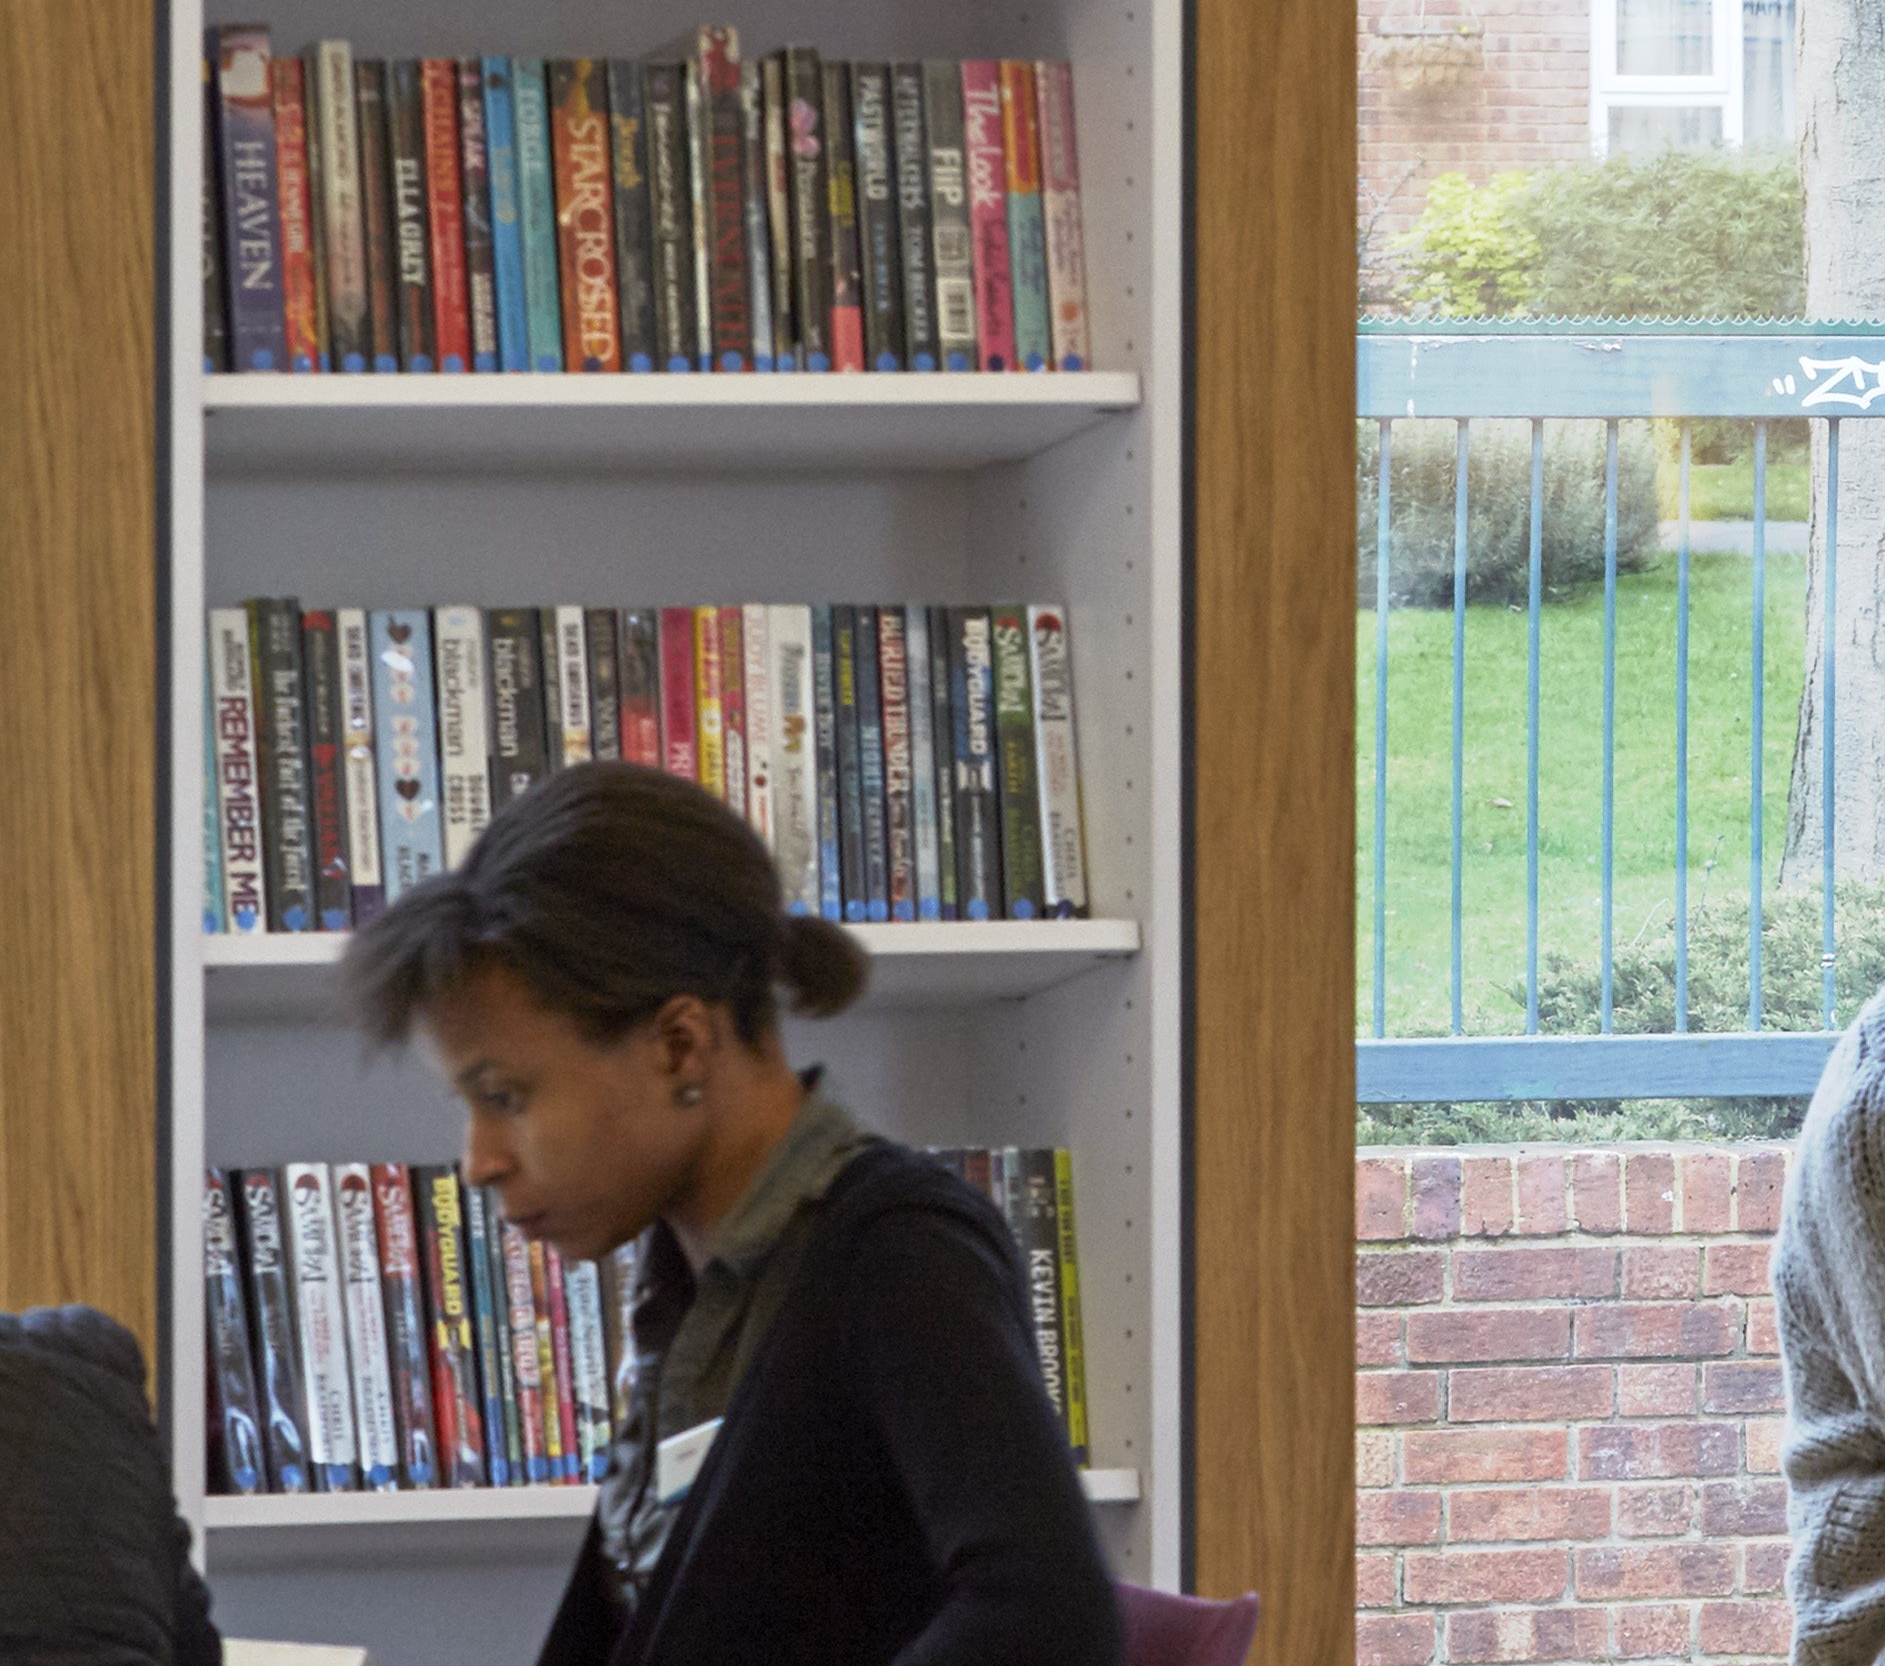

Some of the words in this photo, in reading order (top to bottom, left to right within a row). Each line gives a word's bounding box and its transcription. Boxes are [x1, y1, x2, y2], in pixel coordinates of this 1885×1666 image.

[860, 75, 887, 200] PASTWORLD
[966, 83, 998, 143] The
[234, 140, 274, 291] HEAVEN
[396, 158, 419, 217] ELLA
[970, 145, 1004, 209] Look
[402, 218, 425, 286] GREY
[906, 227, 923, 267] TOM
[441, 638, 468, 757] blackman
[493, 638, 520, 757] blackman
[816, 652, 834, 710] RIVER
[879, 613, 903, 702] BURIED
[963, 616, 992, 755] BODYGUARD
[996, 627, 1026, 712] SAMURAI
[1036, 629, 1068, 721] SAMURAI
[277, 758, 303, 790] Part
[818, 713, 835, 749] BOY
[863, 725, 881, 788] NIGHT
[886, 703, 910, 795] THUNDER
[219, 696, 257, 863] REMEMBER
[315, 770, 345, 881] VALIANT
[230, 871, 260, 919] ME
[245, 1185, 280, 1275] SAMURAI
[293, 1187, 329, 1284] SAMURAI
[339, 1187, 374, 1284] SAMURAI
[378, 1184, 411, 1275] SAMURAI
[431, 1175, 463, 1315] BODYGUARD
[1029, 1248, 1057, 1323] KEVIN
[331, 1389, 345, 1442] CHRIS
[1035, 1329, 1063, 1416] BROOK
